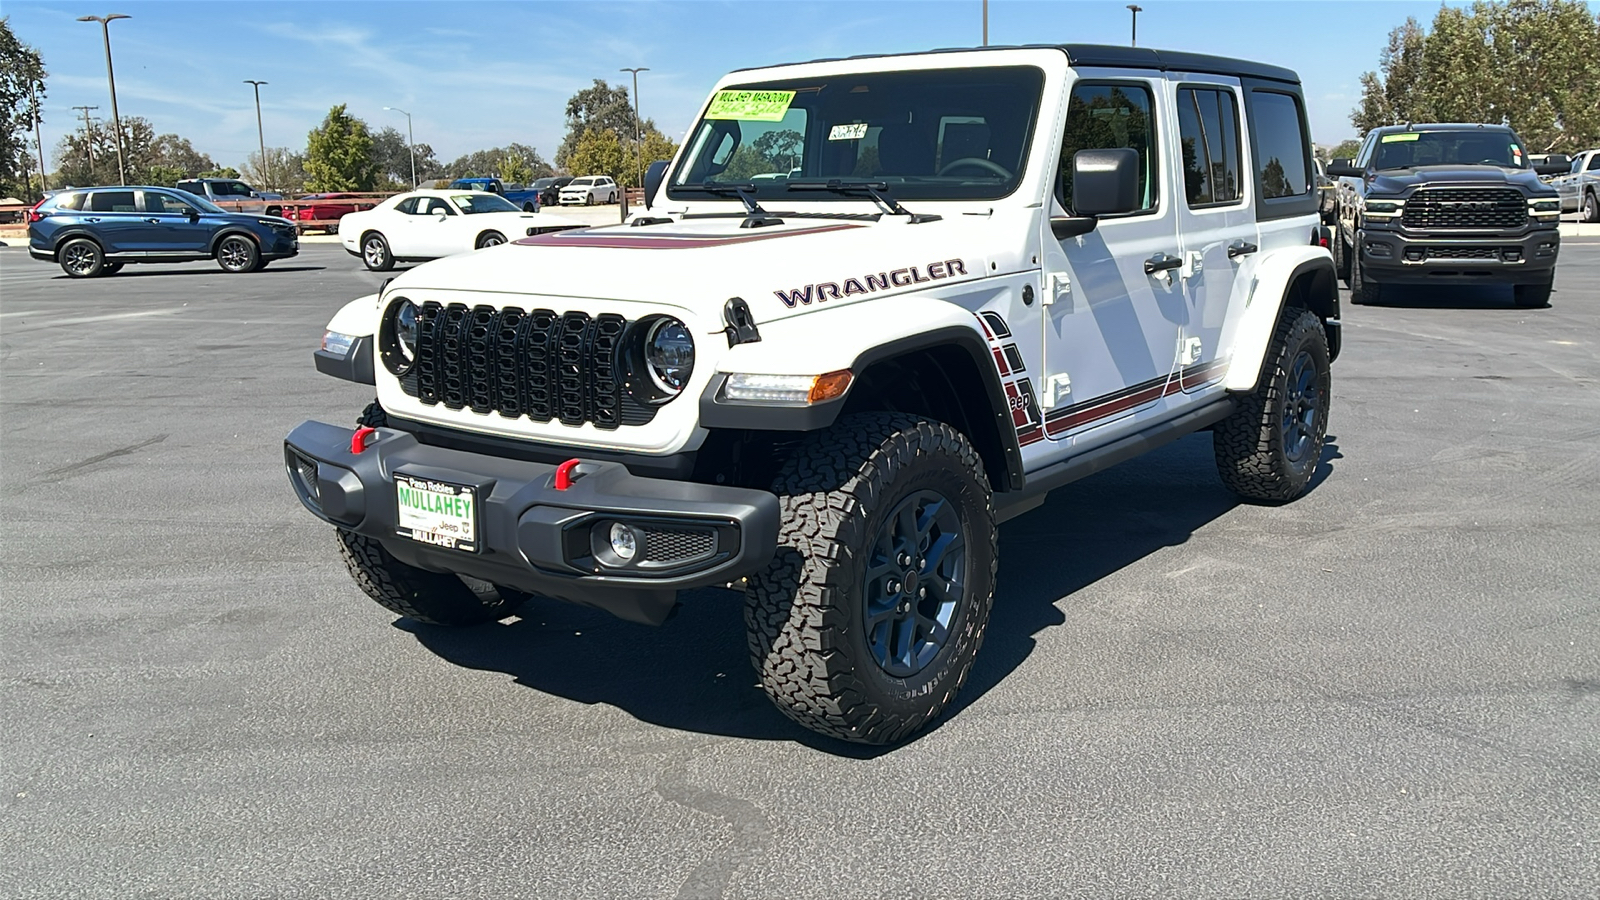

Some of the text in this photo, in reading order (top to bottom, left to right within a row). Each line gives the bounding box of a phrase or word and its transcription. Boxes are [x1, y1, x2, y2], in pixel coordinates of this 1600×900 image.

[718, 92, 791, 104] MULLAHEY MARKDOWN
[773, 258, 968, 309] WRANGLER
[1008, 392, 1030, 412] eep
[409, 477, 427, 490] Paso
[427, 481, 455, 495] Robles
[399, 486, 471, 520] MULLAHEY
[438, 520, 459, 533] Jeep
[412, 527, 458, 549] MULLAHEY
